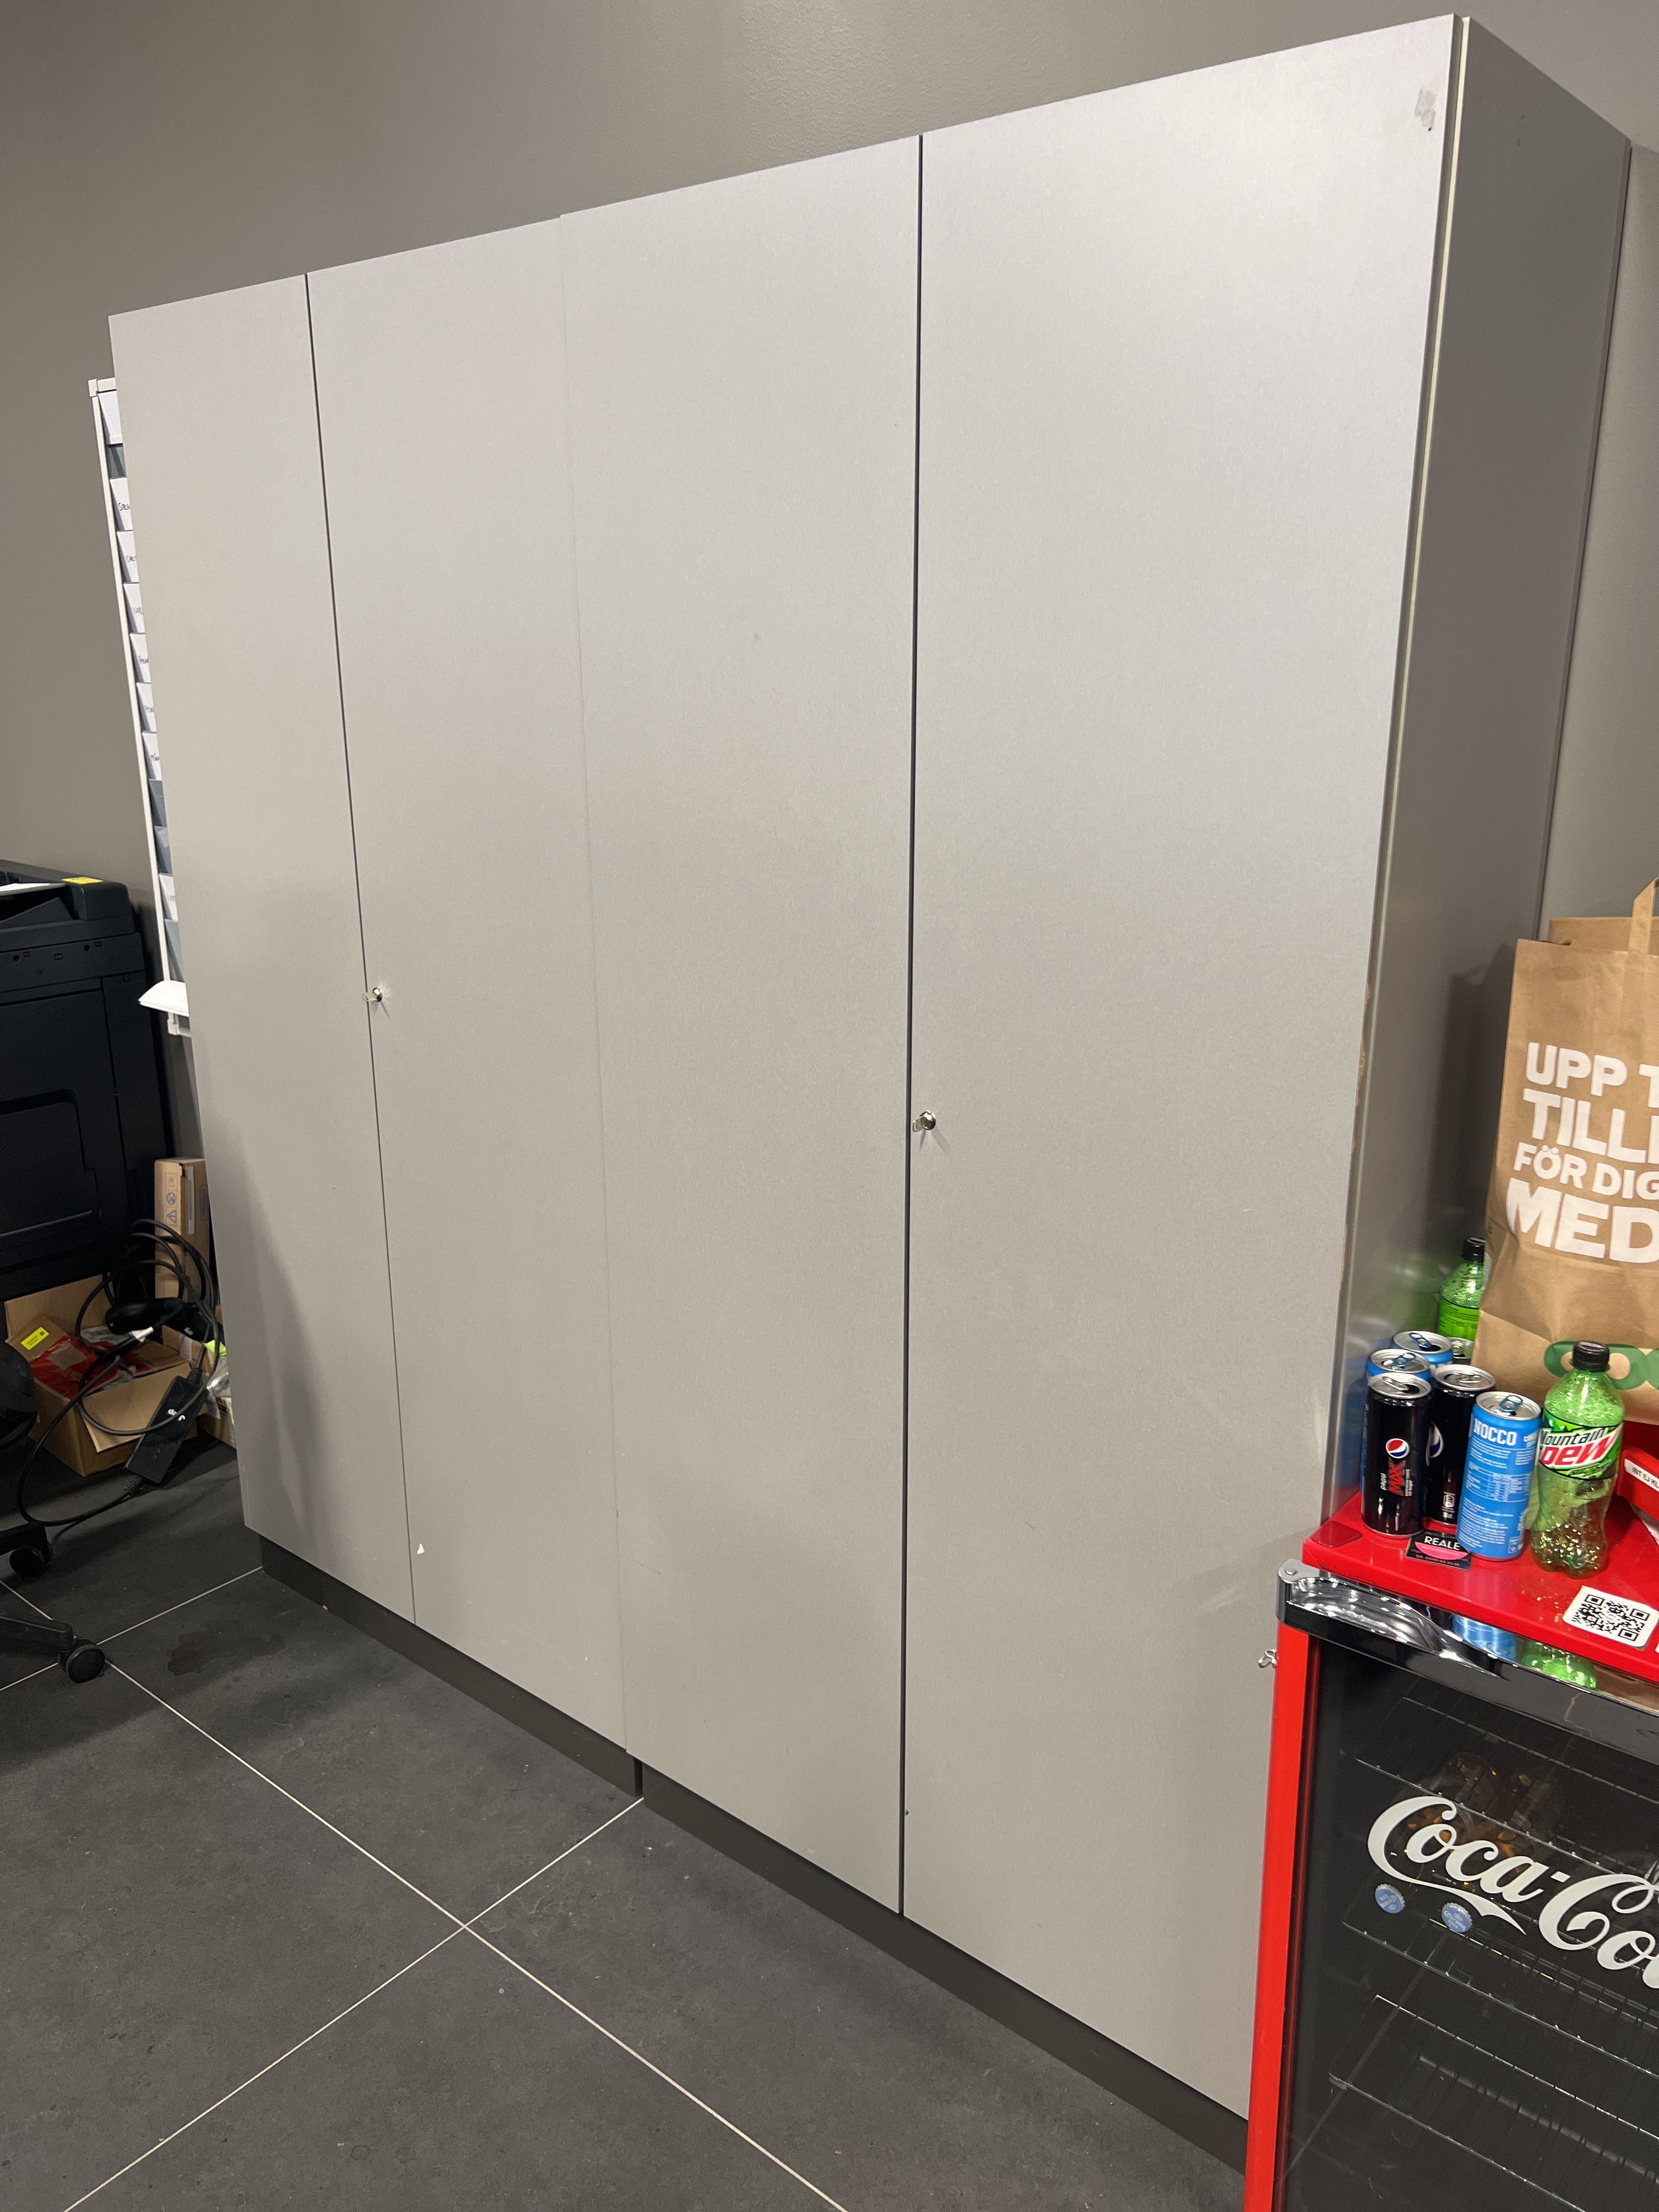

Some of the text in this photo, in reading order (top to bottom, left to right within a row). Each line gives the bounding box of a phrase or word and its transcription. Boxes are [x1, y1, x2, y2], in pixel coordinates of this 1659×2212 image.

[1526, 1042, 1628, 1097] UPP
[1513, 1142, 1659, 1200] FÖR DIG
[1474, 1418, 1516, 1446] NOCCO
[1388, 1458, 1406, 1496] MAX
[1424, 1536, 1460, 1551] REALE
[1368, 1796, 1659, 1989] Coca-Co
